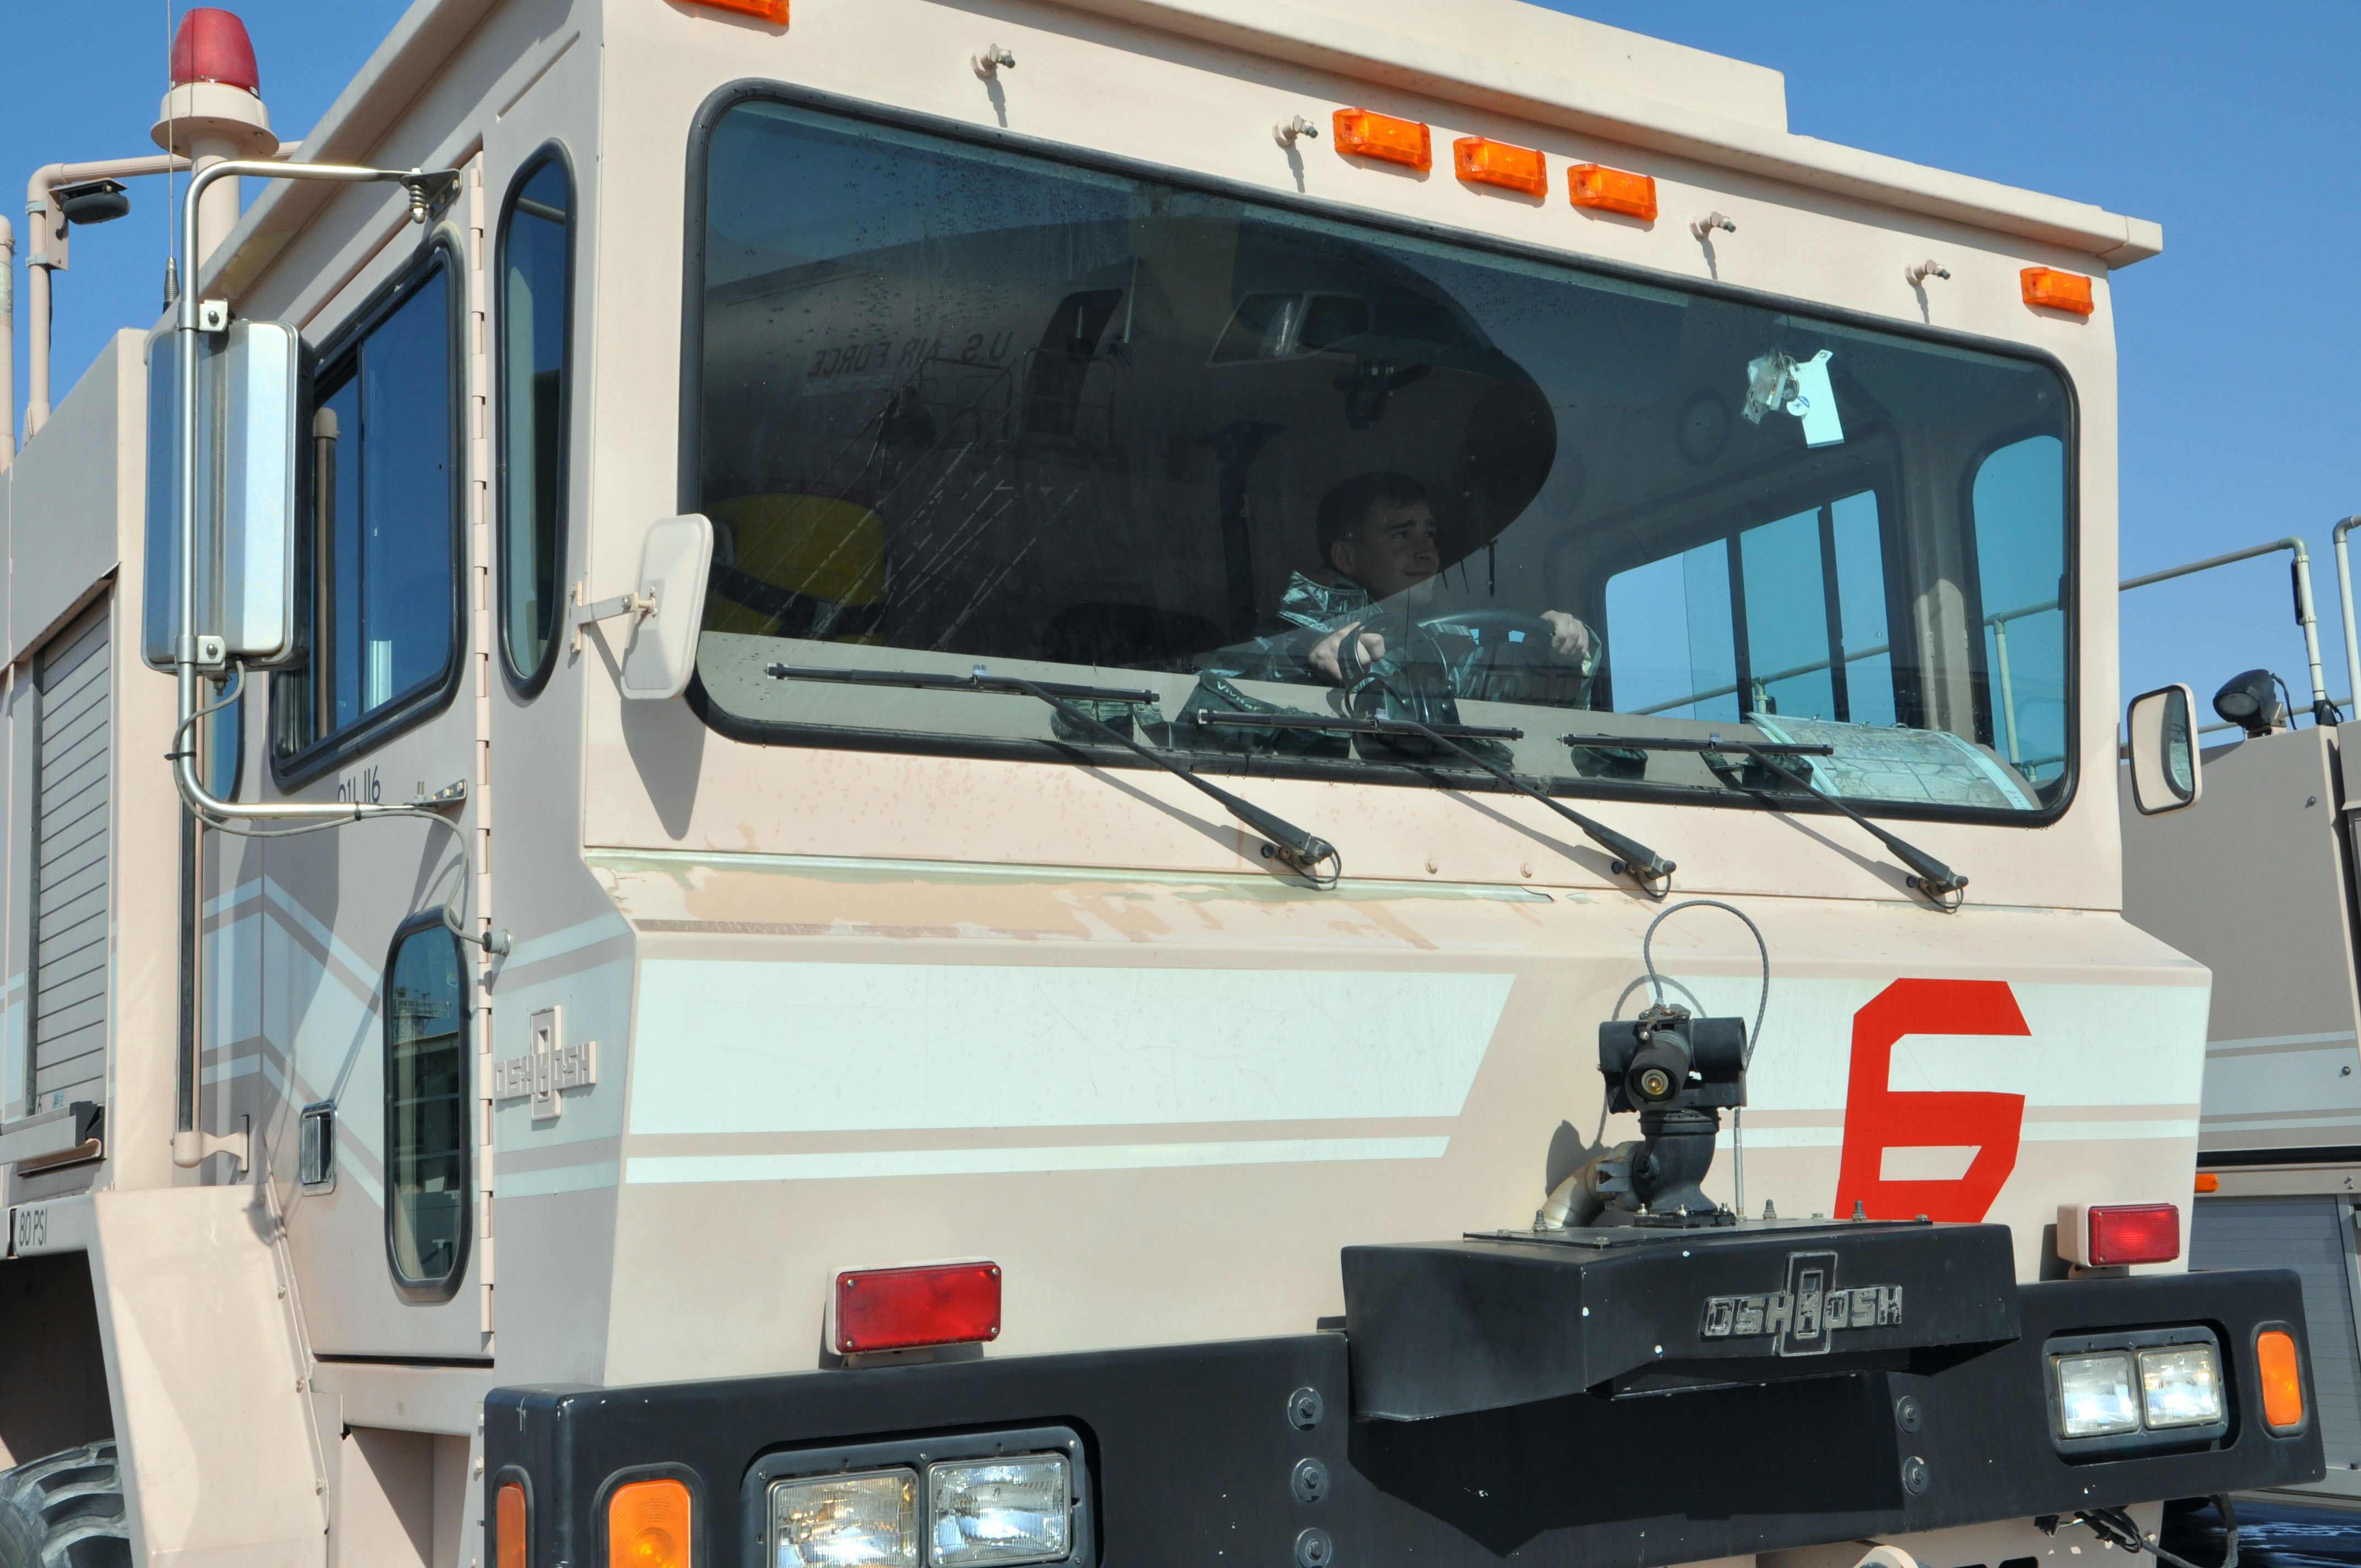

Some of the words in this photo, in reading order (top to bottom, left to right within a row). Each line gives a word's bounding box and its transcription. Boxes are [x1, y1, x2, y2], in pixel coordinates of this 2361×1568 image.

[1216, 680, 1263, 711] Vivitar
[493, 1025, 596, 1104] OSHKOSH
[1834, 978, 2032, 1223] 6
[19, 1211, 31, 1247] 80
[33, 1208, 47, 1246] PSI
[1701, 1268, 1903, 1341] OSHKOSH
